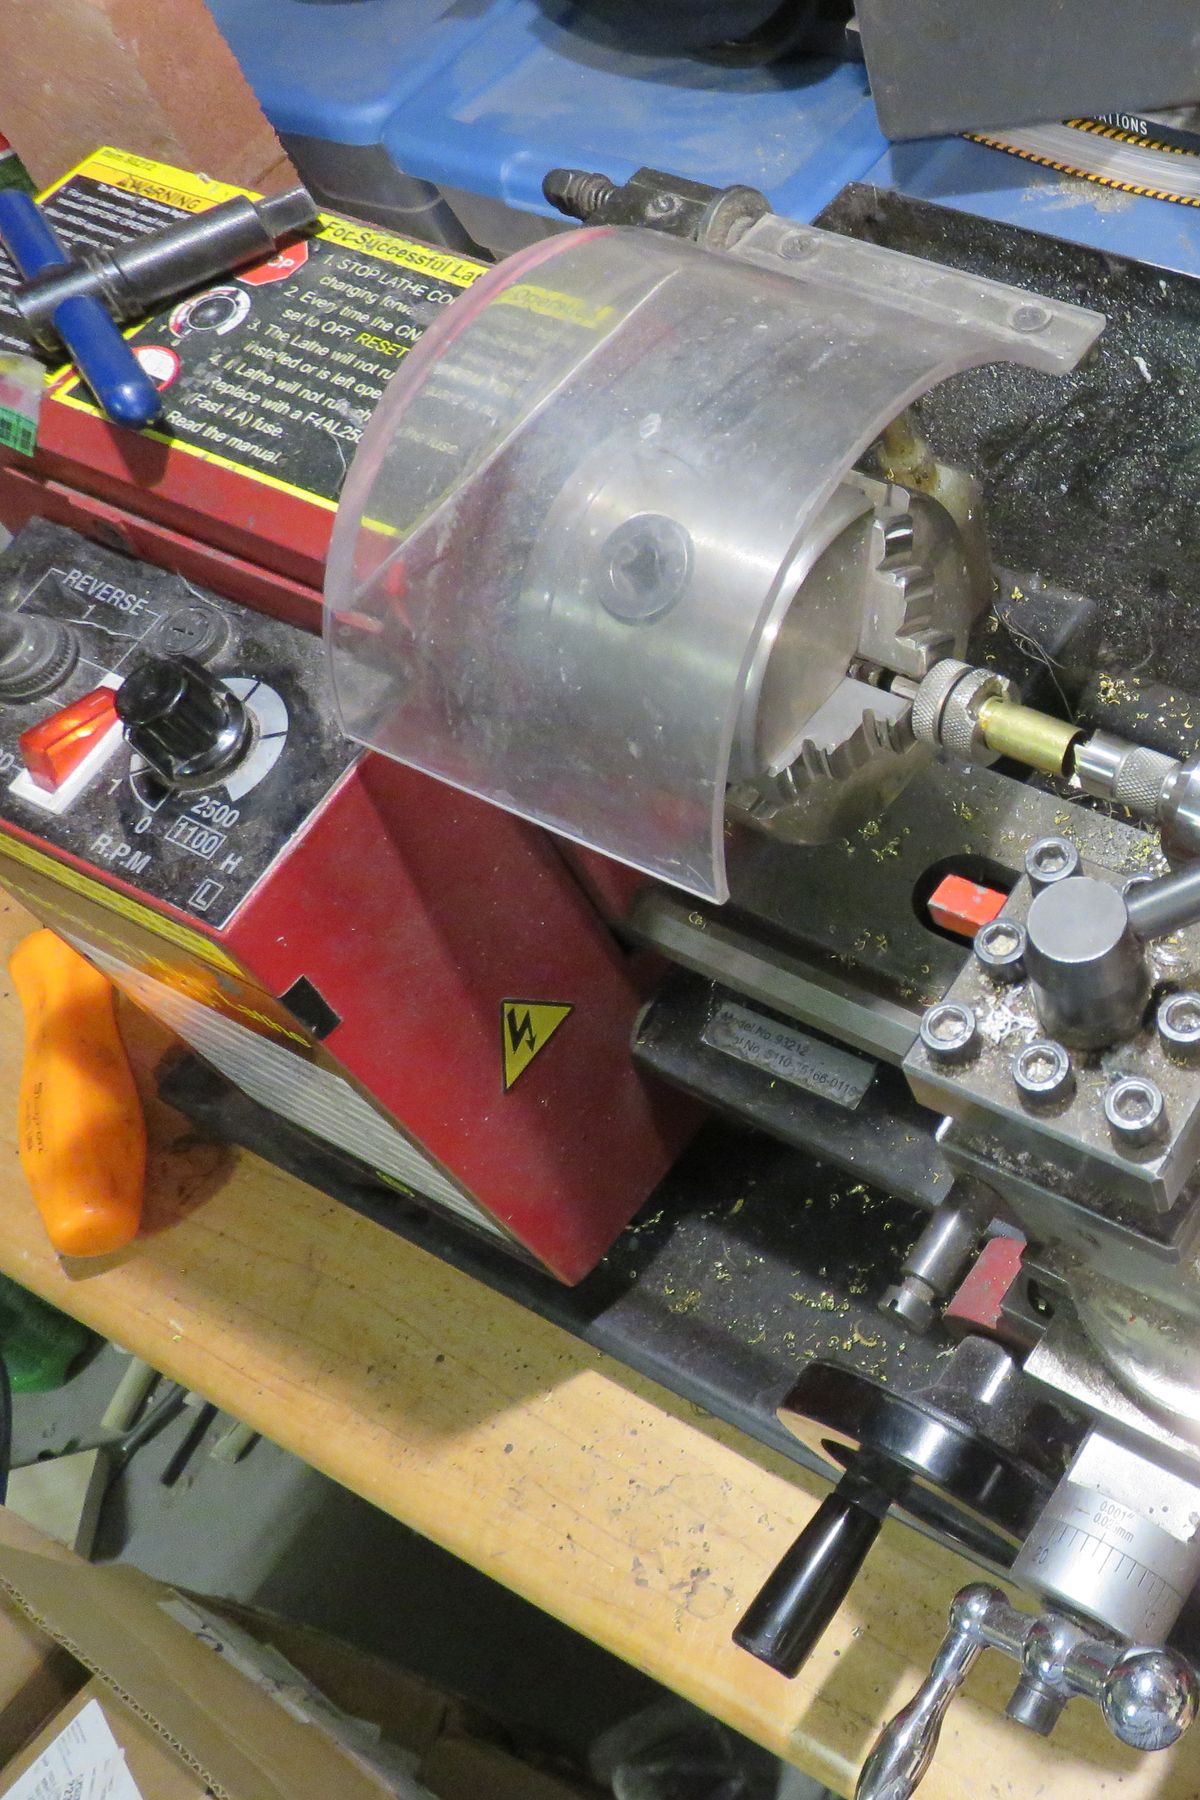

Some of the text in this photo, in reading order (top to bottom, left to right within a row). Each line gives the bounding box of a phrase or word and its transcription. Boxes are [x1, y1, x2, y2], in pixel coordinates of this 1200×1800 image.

[127, 174, 201, 209] WARNING
[267, 255, 295, 269] OP
[327, 221, 355, 242] For
[354, 231, 452, 273] Successful
[320, 274, 379, 305] changing
[323, 254, 456, 305] 1. STOP LATHE CO
[283, 285, 296, 299] 2.
[299, 290, 339, 314] Every
[339, 302, 369, 323] time
[370, 316, 394, 332] the
[247, 319, 396, 380] 3. The Lathe will not ru
[281, 306, 303, 321] set
[304, 314, 320, 328] to
[354, 332, 411, 359] RESET
[234, 362, 275, 386] Lathe
[275, 378, 302, 396] will
[298, 388, 326, 405] not
[243, 340, 383, 400] installed or is left ope
[185, 391, 225, 416] (Fast
[251, 418, 283, 439] fuse.
[207, 376, 261, 404] Replace
[260, 398, 292, 416] with
[291, 409, 303, 421] a
[165, 410, 280, 465] Read the manual.
[63, 568, 149, 616] REVERSE
[82, 604, 96, 619] 1
[107, 778, 123, 795] 1
[134, 816, 152, 834] 0
[190, 796, 240, 828] 2500
[90, 834, 152, 874] R.P.M
[173, 822, 219, 854] 1100
[219, 853, 243, 874] H
[195, 884, 211, 906] L
